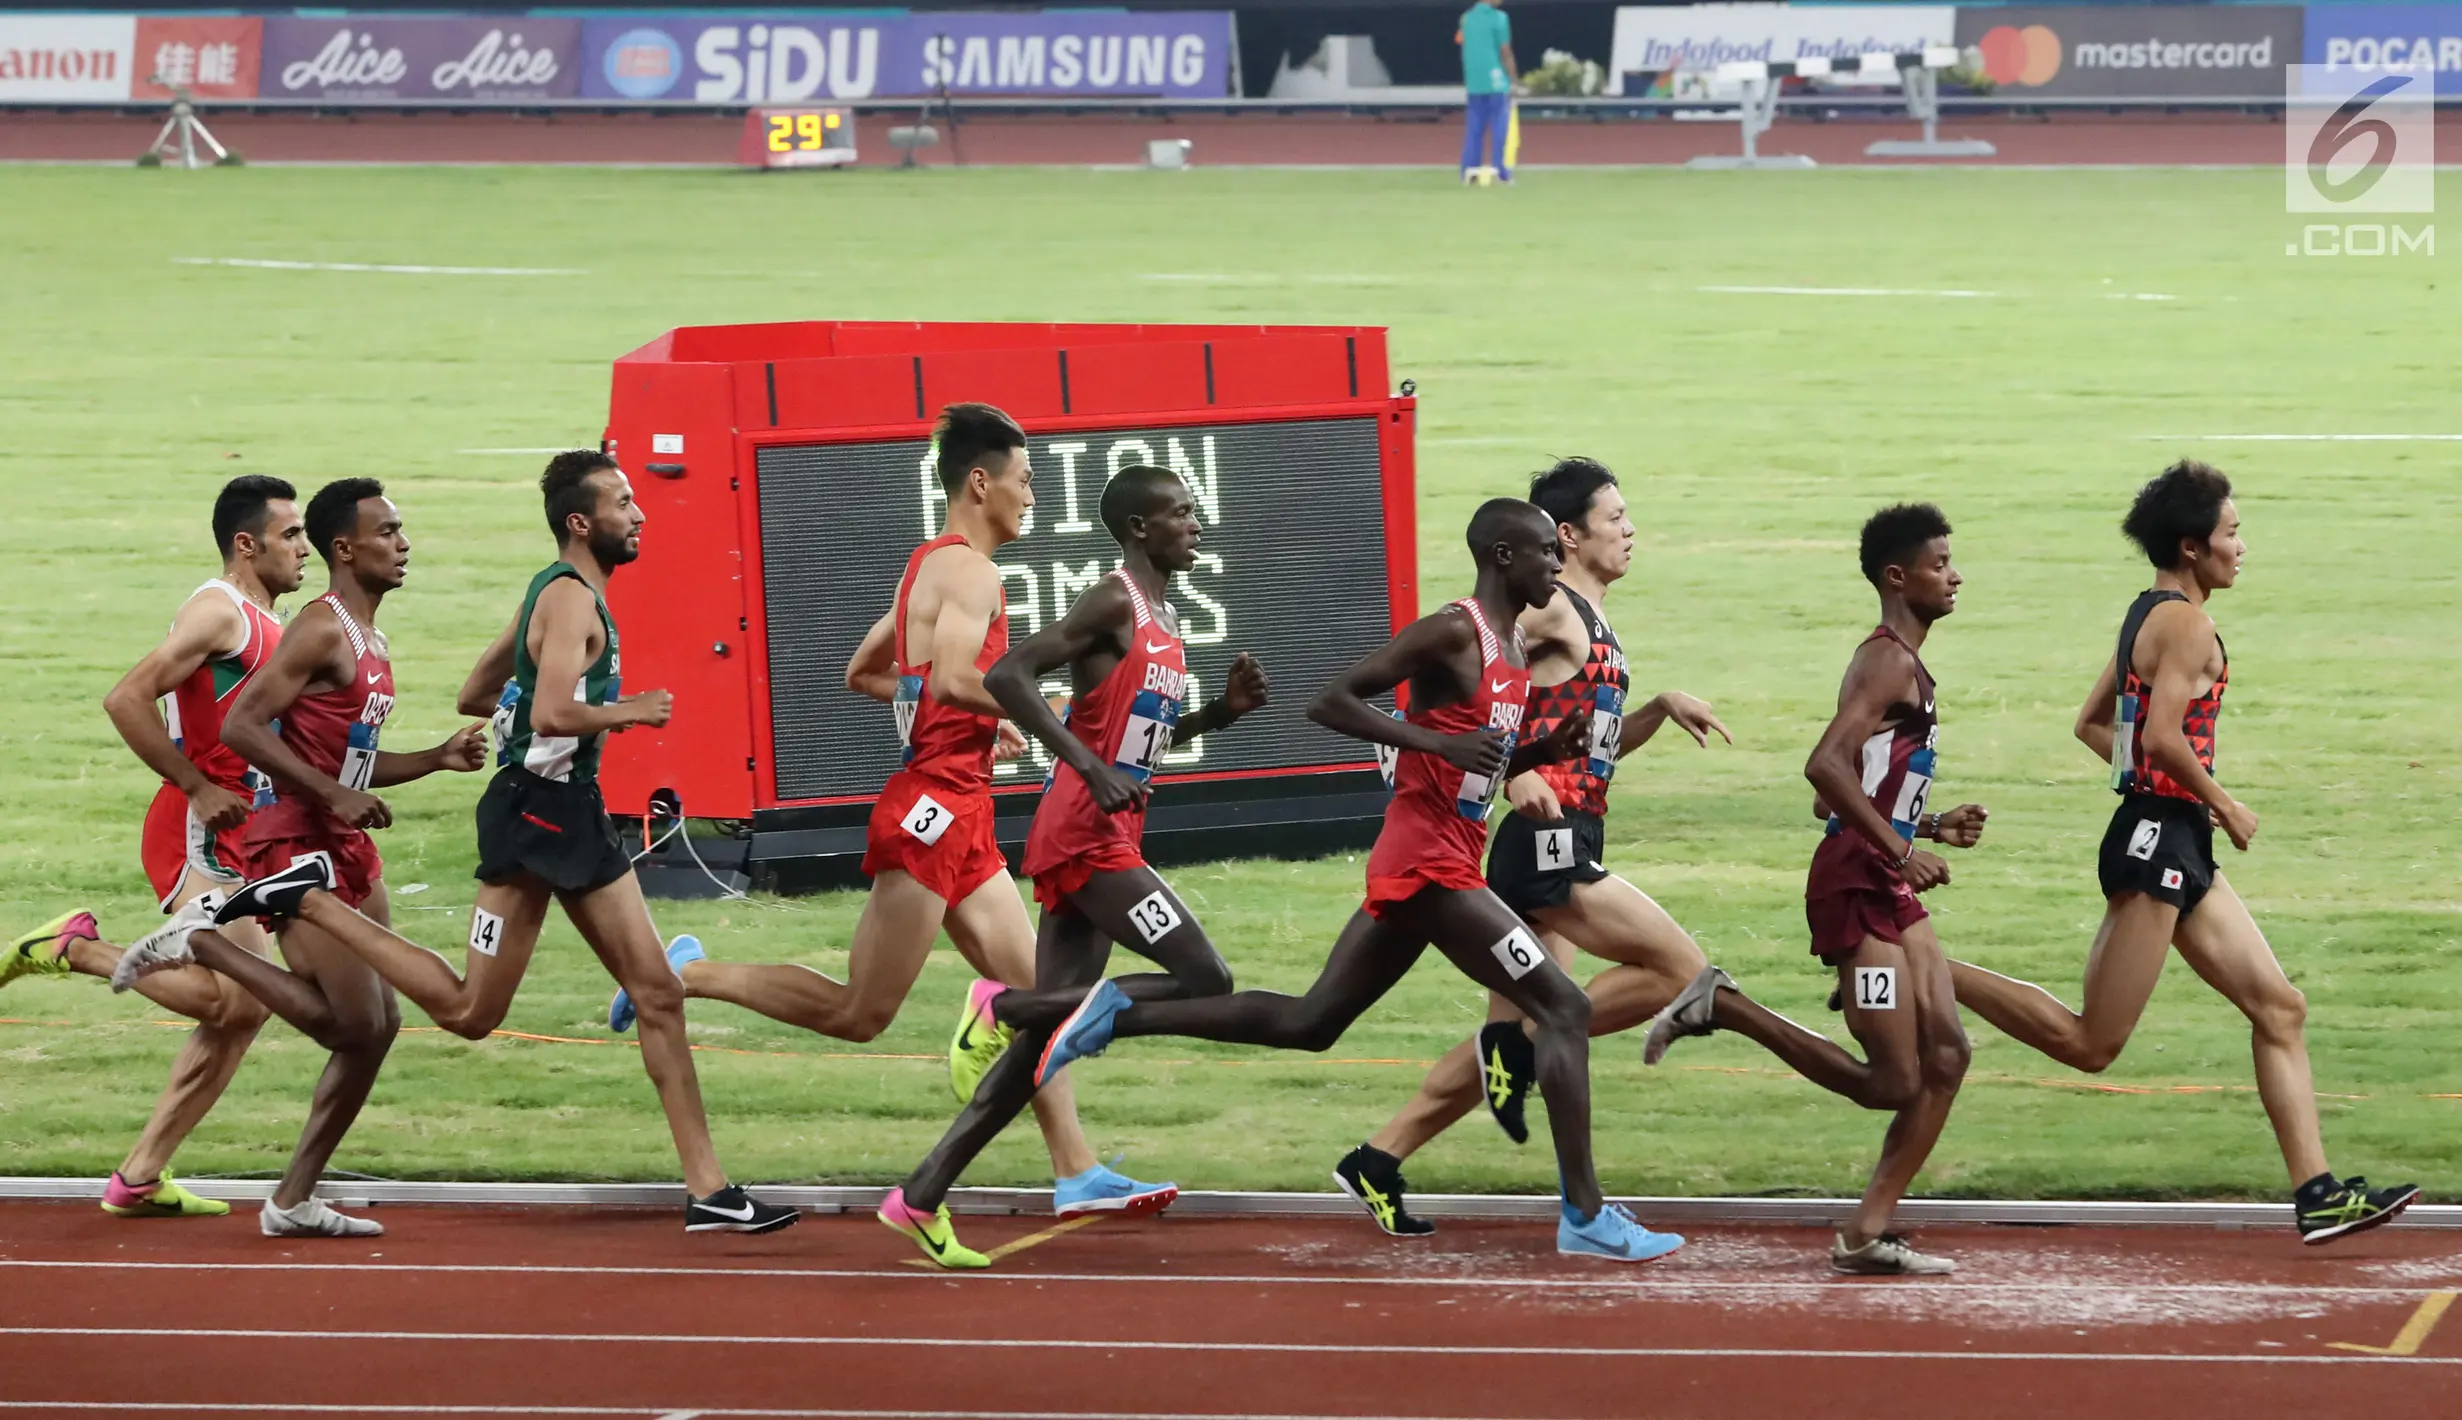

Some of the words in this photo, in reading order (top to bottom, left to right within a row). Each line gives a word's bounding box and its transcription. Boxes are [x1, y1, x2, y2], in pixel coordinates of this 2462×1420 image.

[154, 41, 238, 84] 佳能
[282, 29, 406, 90] Aice
[432, 29, 558, 90] Aice
[922, 34, 1203, 87] SAMSUNG
[1642, 37, 1773, 69] Indofood
[2076, 37, 2274, 69] mastercard
[2326, 37, 2462, 72] POCAR
[914, 807, 938, 833] 3
[1547, 833, 1560, 863] 4
[2136, 827, 2158, 854] 2
[473, 914, 494, 949] 14
[1135, 900, 1170, 936] 13
[1508, 939, 1530, 966] 6
[1861, 972, 1889, 1004] 12
